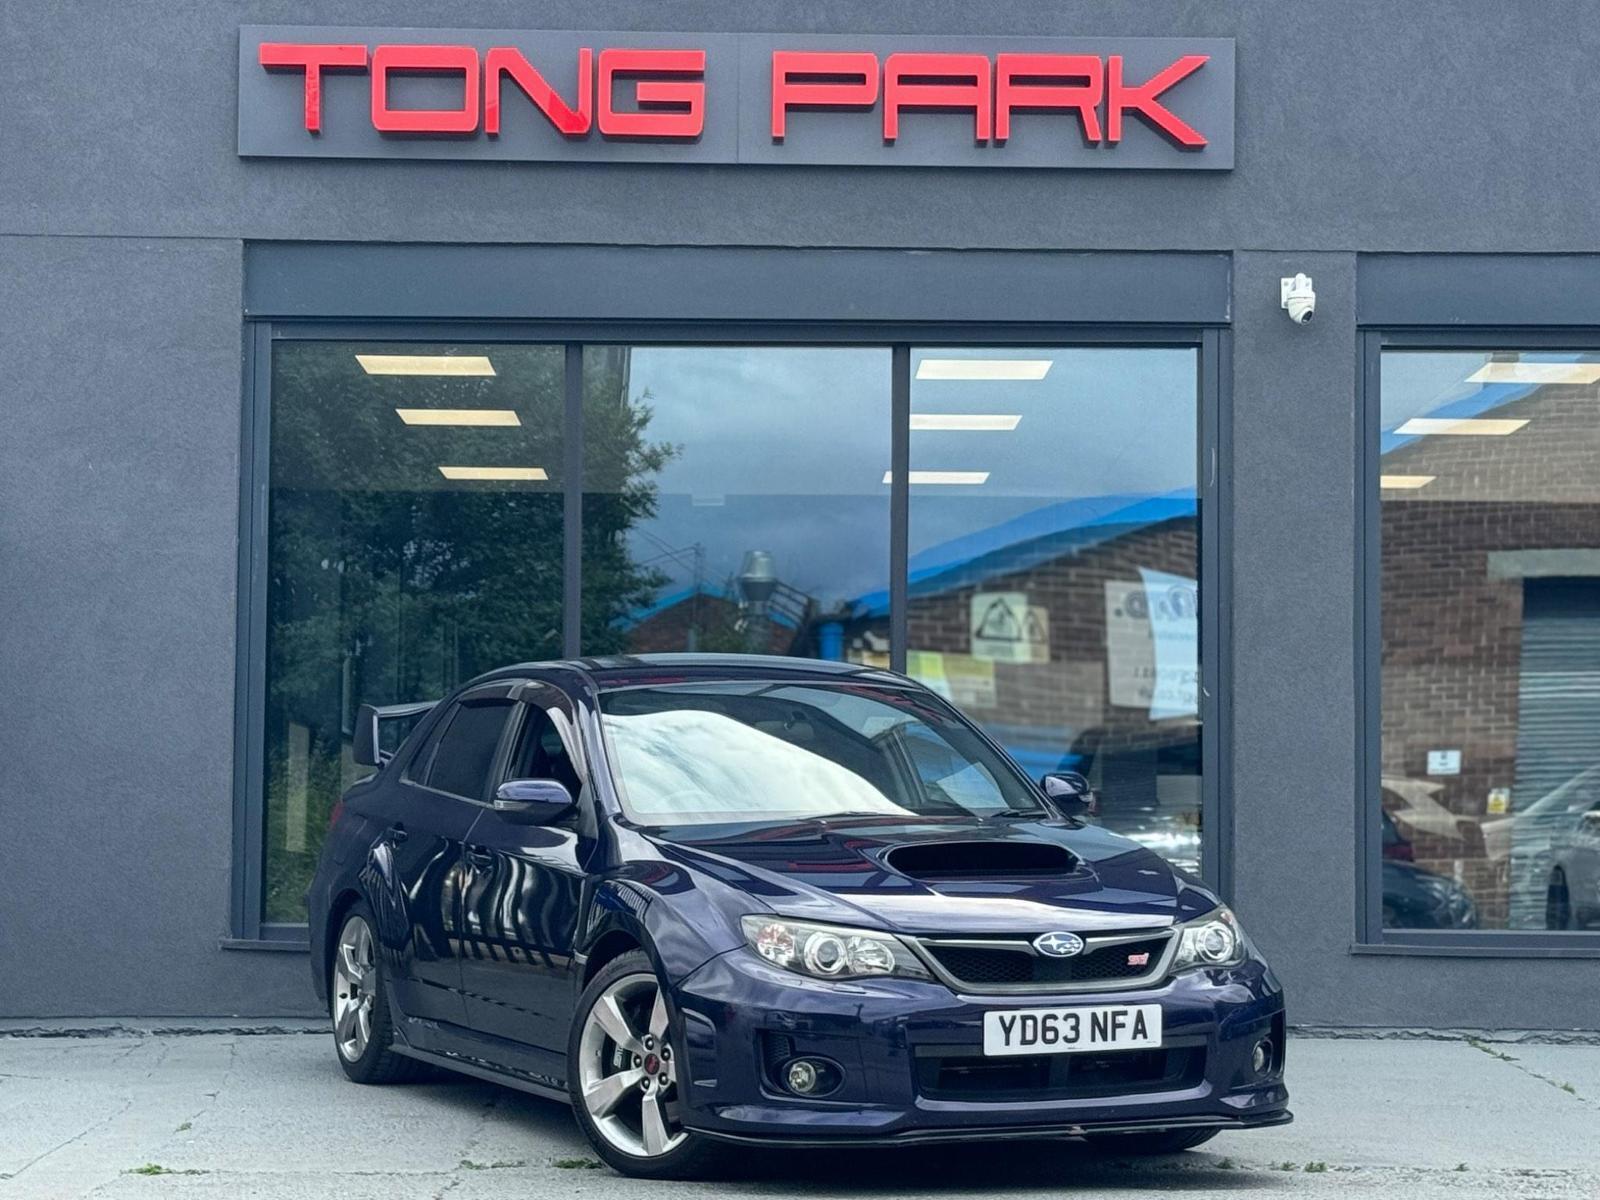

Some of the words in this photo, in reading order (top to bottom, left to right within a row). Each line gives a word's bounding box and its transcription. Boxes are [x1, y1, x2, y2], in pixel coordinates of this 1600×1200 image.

[259, 43, 706, 136] TONG
[771, 51, 1210, 146] PARK
[999, 1012, 1081, 1047] YD63
[1090, 1009, 1149, 1043] NFA
